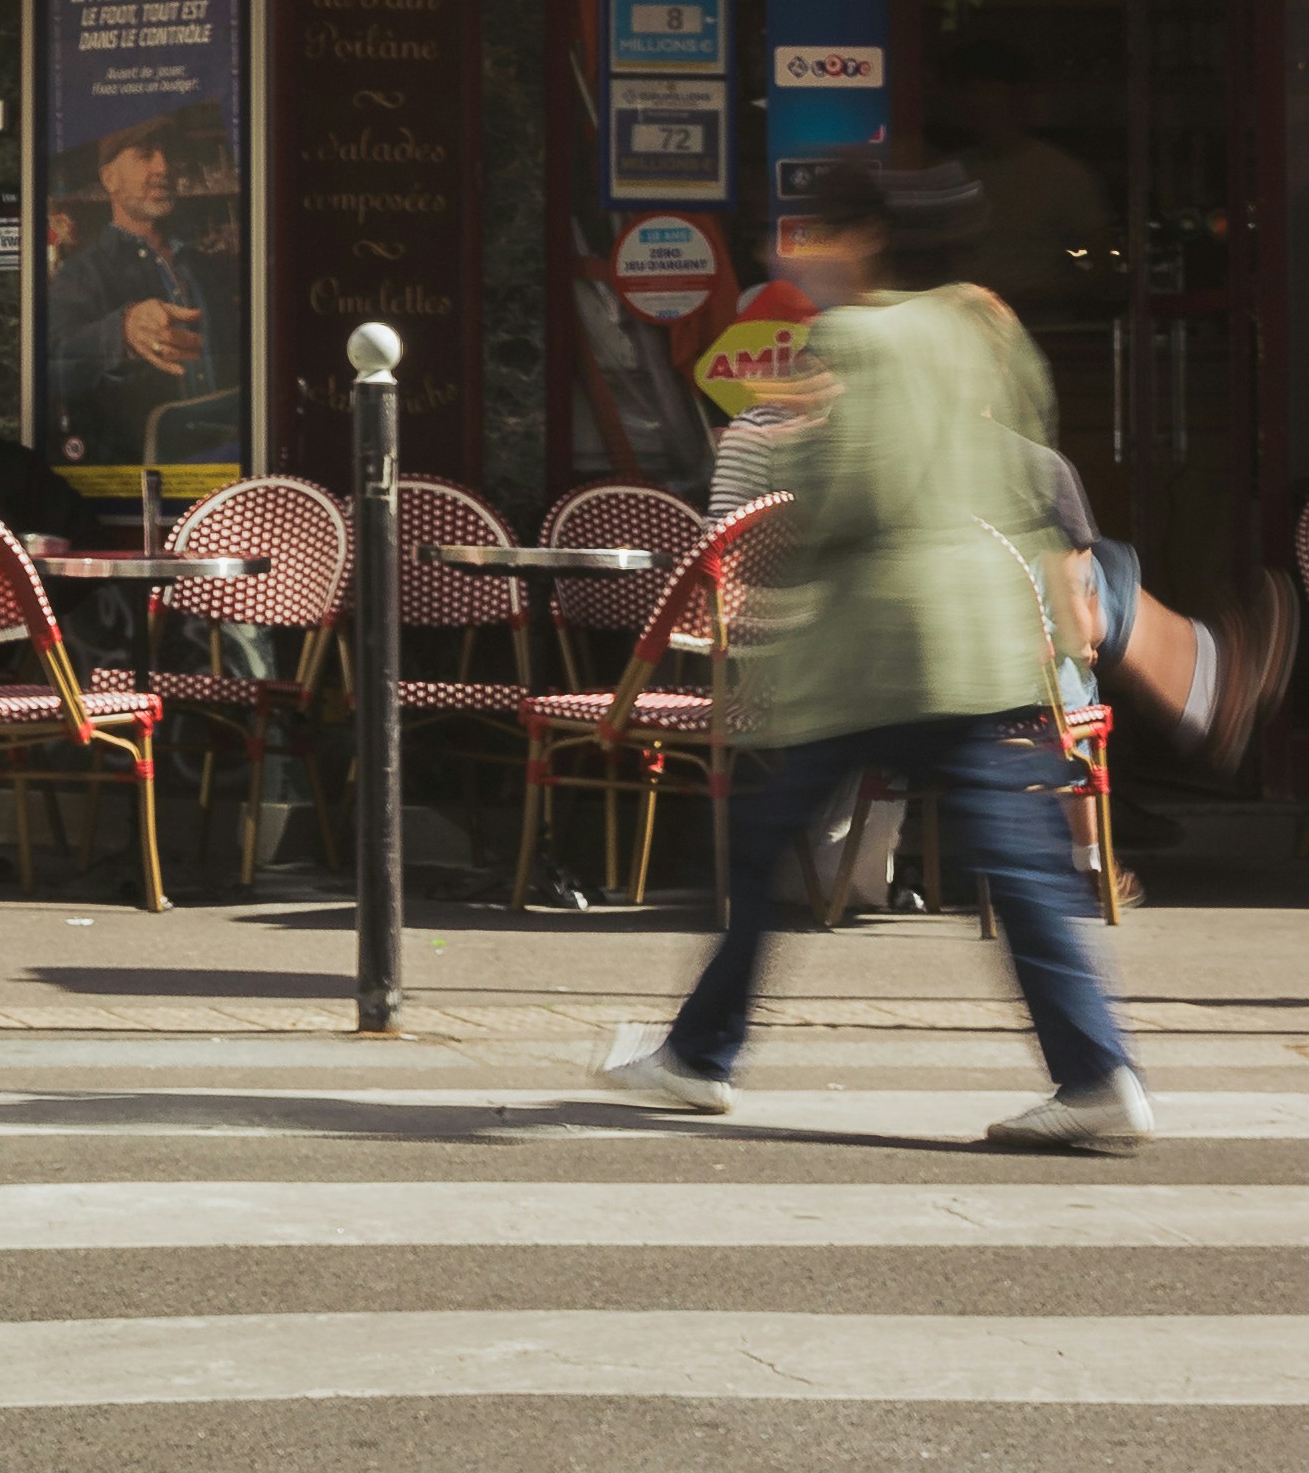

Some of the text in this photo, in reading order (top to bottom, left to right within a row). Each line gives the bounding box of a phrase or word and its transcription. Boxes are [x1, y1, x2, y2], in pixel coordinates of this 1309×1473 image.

[80, 6, 99, 27] LE
[142, 1, 181, 22] TOUT
[181, 0, 209, 19] EST
[666, 7, 684, 30] 8
[78, 22, 212, 52] DANS LE CONTRÔLE
[303, 20, 440, 63] Poilâne
[620, 37, 695, 54] MILLIONS
[302, 125, 447, 165] Salades
[659, 127, 692, 151] 72
[303, 181, 448, 226] composées
[308, 276, 452, 318] Omelettes
